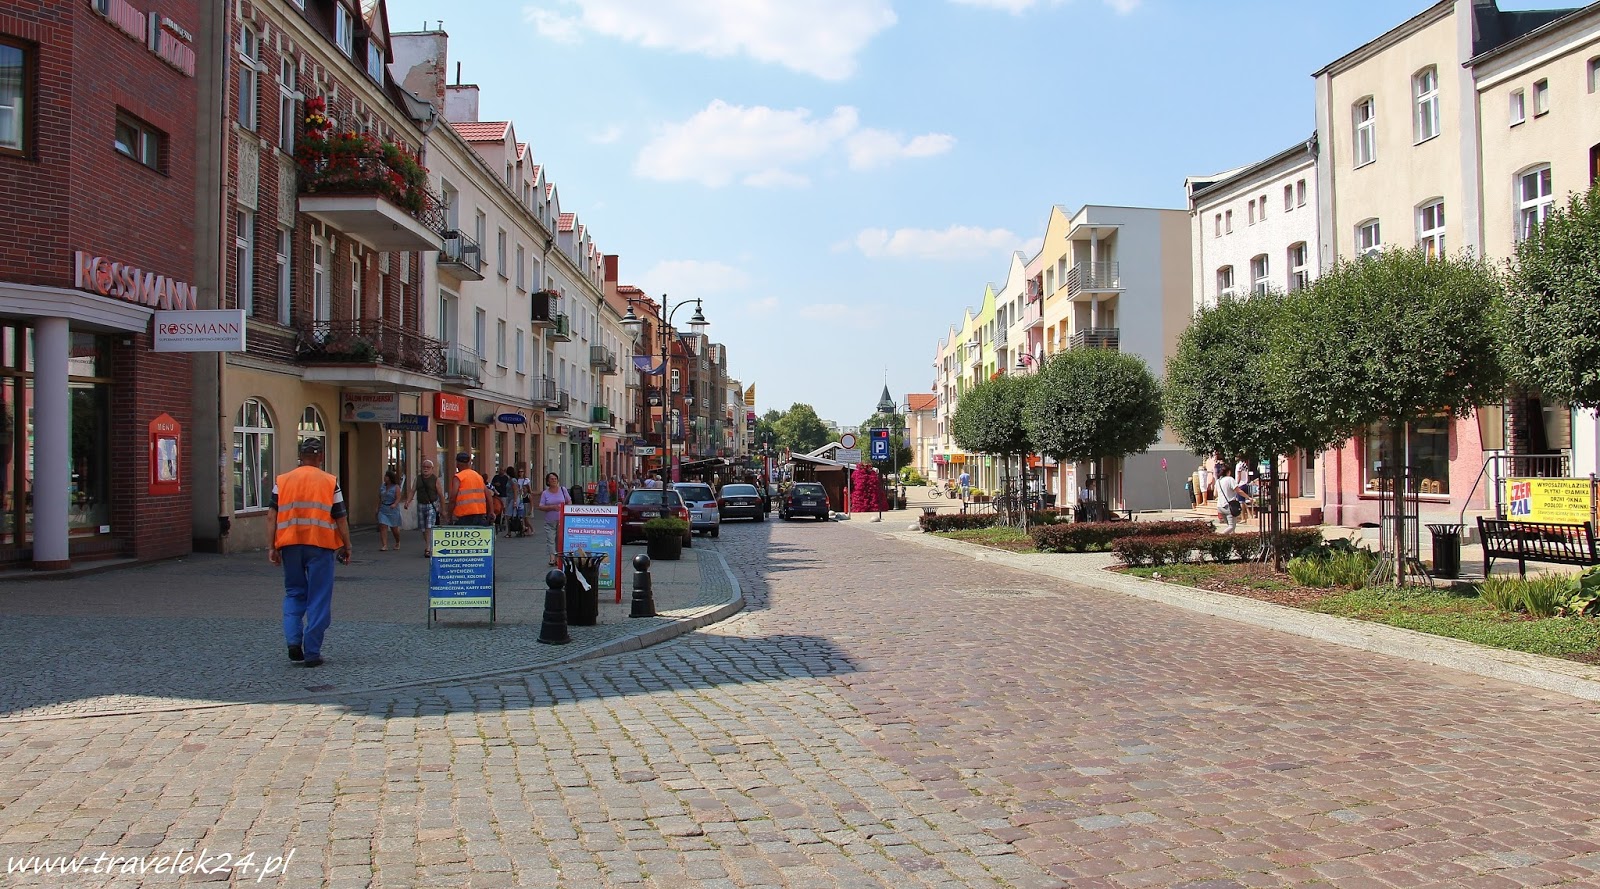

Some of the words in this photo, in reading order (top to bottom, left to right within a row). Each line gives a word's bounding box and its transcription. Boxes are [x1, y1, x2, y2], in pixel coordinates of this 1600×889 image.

[75, 250, 197, 310] ROSSMANN
[159, 323, 239, 335] ROSSMANN
[579, 430, 586, 440] T
[876, 442, 884, 453] P
[1510, 499, 1530, 515] ZAL
[434, 538, 490, 546] PODRÓŻY
